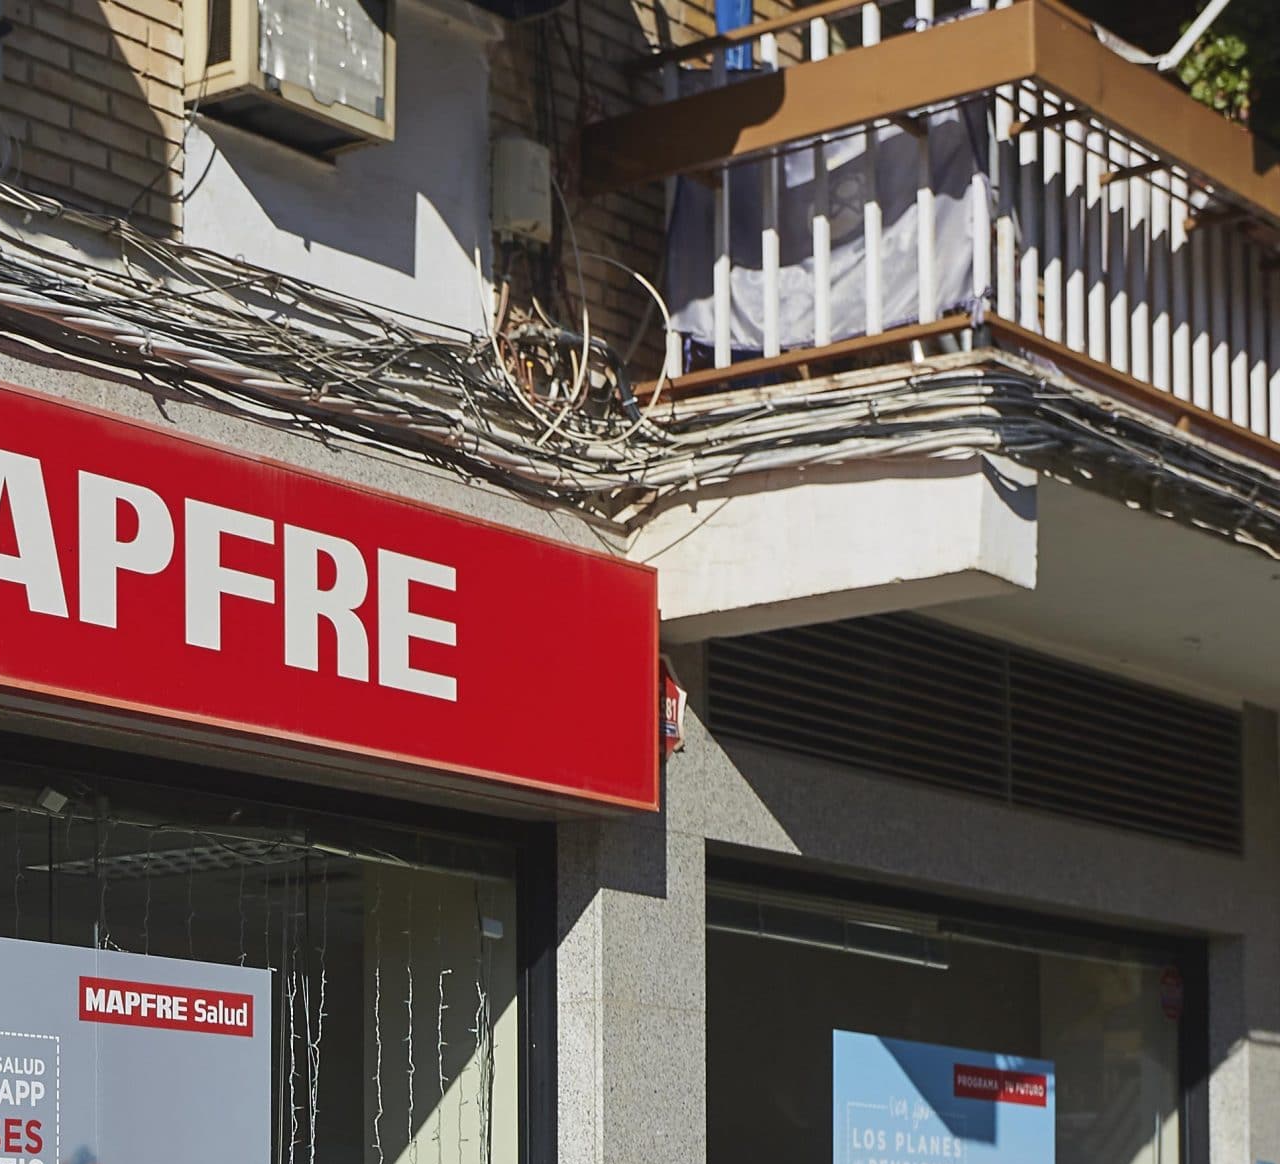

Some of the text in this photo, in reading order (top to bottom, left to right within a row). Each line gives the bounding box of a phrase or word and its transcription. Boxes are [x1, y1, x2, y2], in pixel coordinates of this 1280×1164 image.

[85, 987, 248, 1027] MAPFRE Salud
[852, 1128, 962, 1158] LOS PLANES
